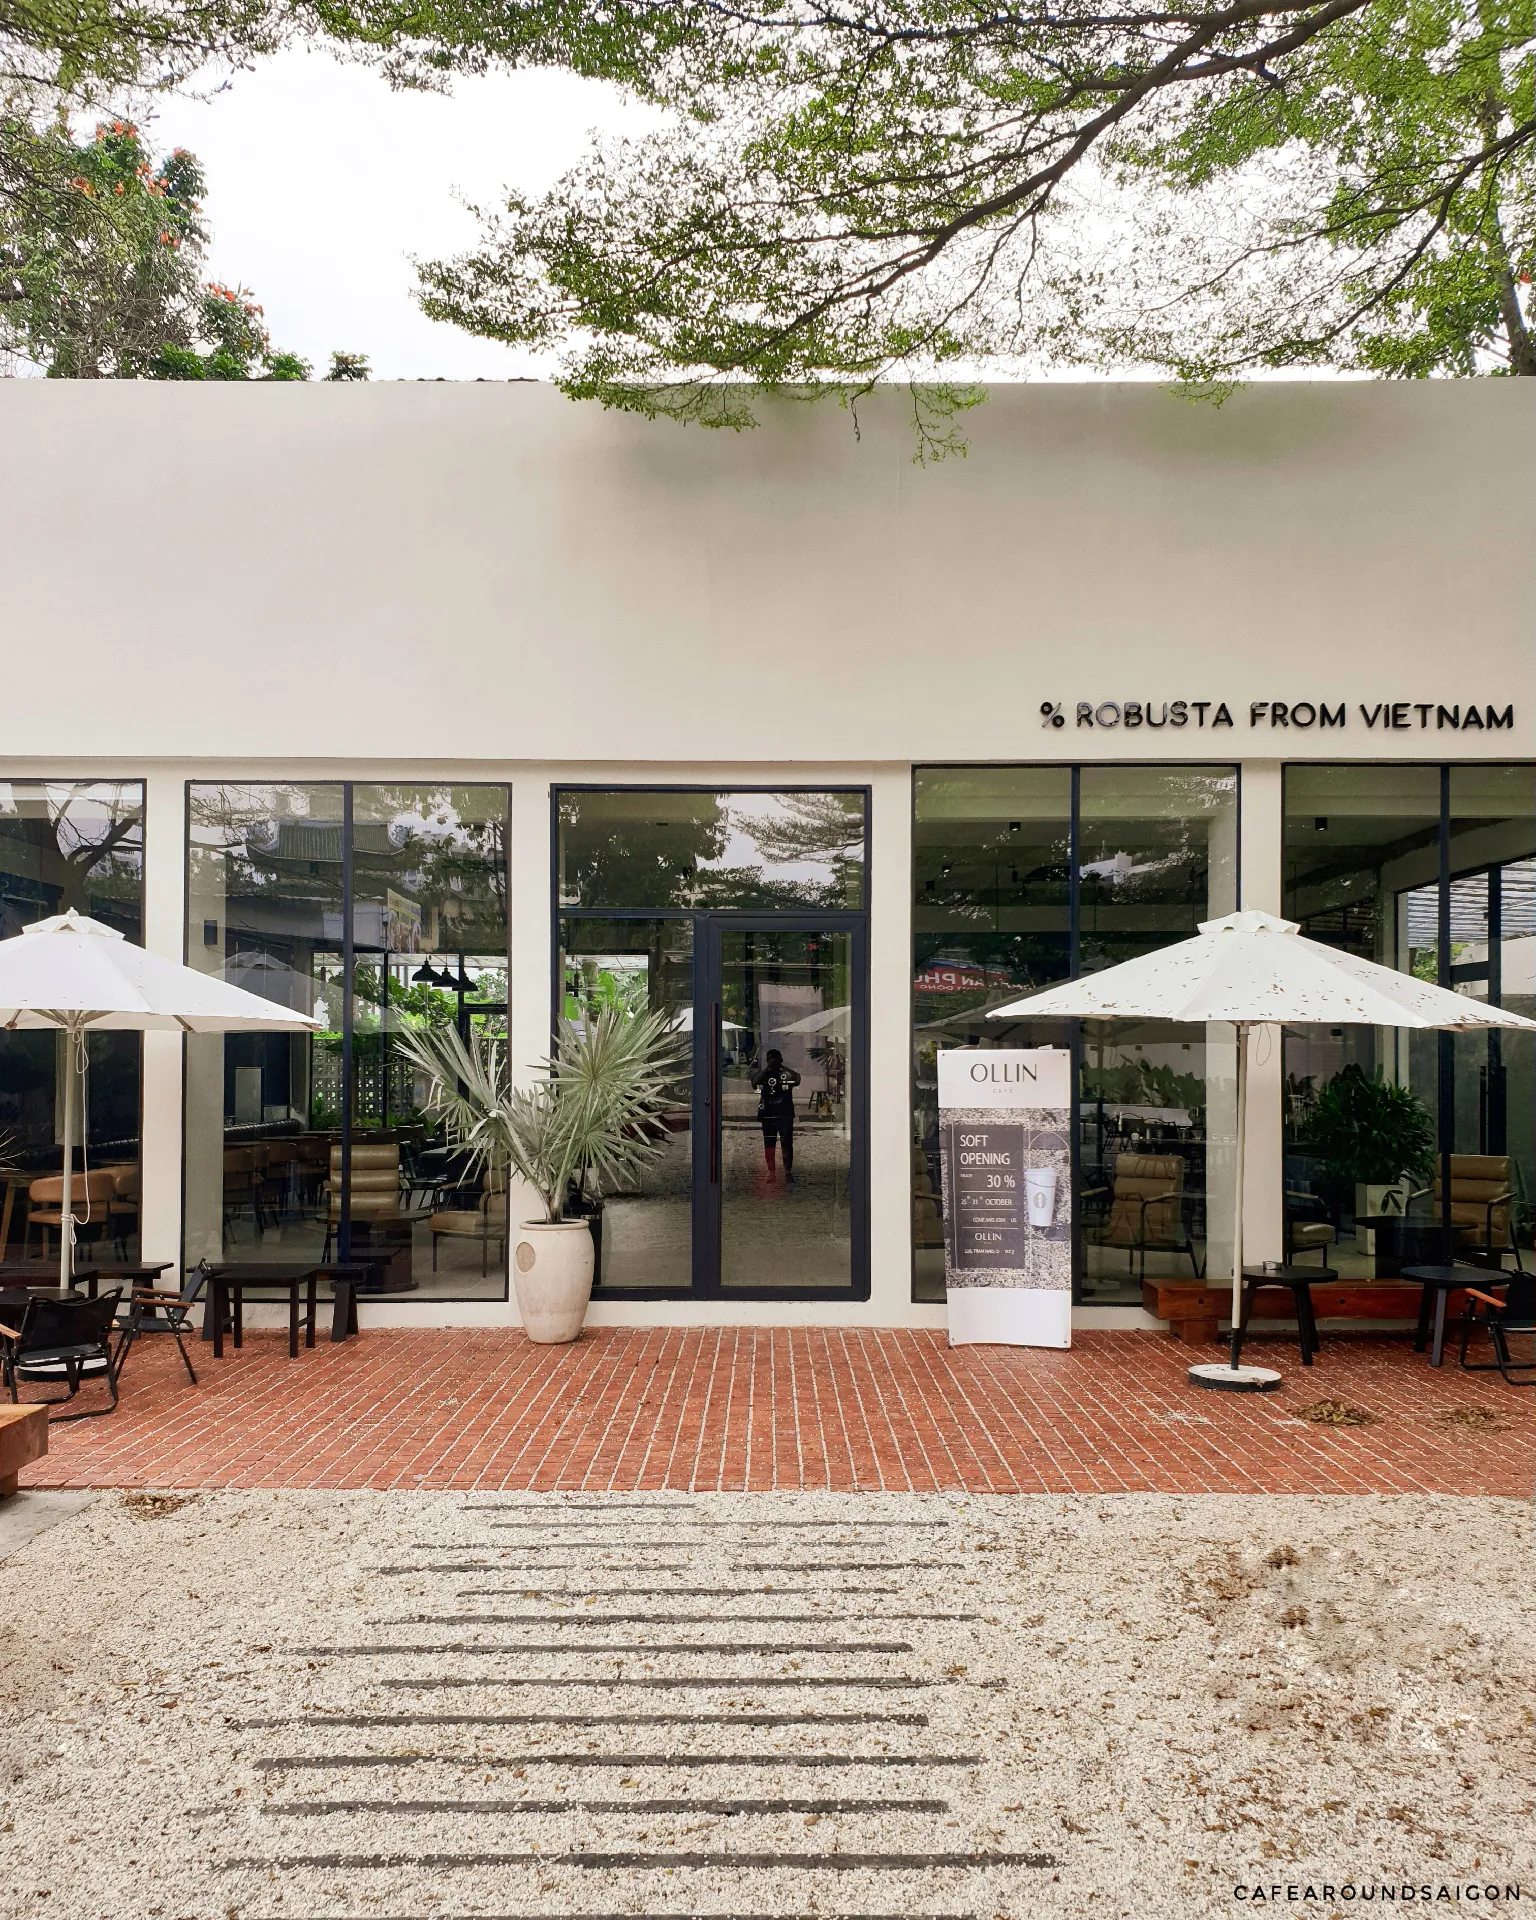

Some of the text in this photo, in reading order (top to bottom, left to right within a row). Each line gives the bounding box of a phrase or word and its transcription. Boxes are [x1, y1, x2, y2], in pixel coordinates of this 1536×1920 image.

[1039, 700, 1515, 729] % ROBUSTA FROM VIETNAM
[970, 1063, 1037, 1083] OLLIN
[959, 1134, 989, 1147] SOFT
[960, 1152, 1011, 1165] OPENING
[986, 1174, 1016, 1188] 30 %
[984, 1198, 1013, 1206] OCTOBER
[974, 1232, 1002, 1241] OLLIN
